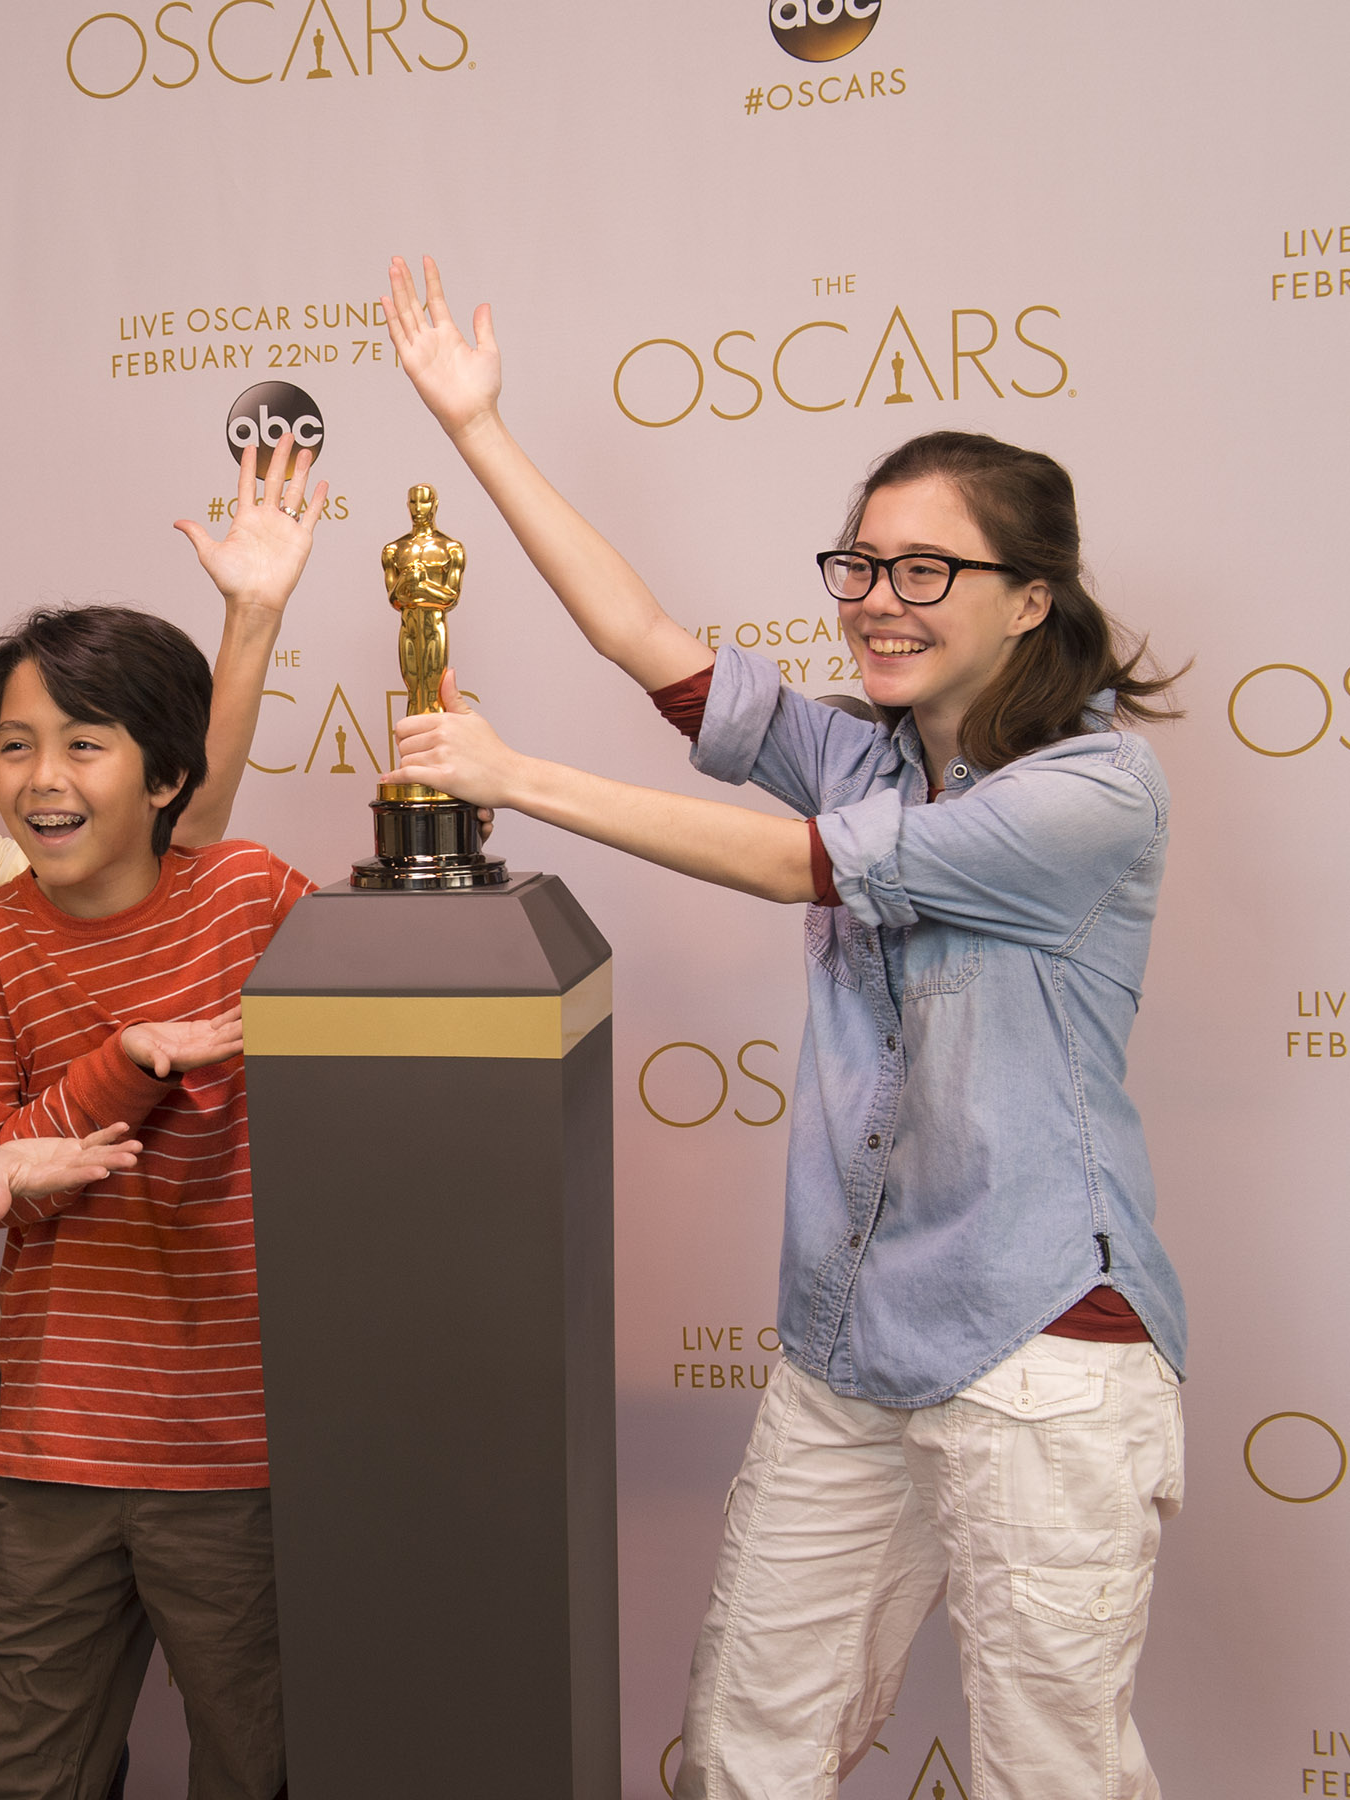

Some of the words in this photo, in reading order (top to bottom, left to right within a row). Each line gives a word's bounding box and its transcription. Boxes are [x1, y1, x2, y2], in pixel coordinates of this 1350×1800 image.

[744, 67, 907, 116] #OSCARS
[1283, 225, 1350, 258] LIVE
[811, 274, 857, 297] THE
[119, 311, 175, 341] LIVE
[186, 305, 291, 333] OSCAR
[303, 301, 390, 330] SUND
[111, 343, 254, 379] FEBRUARY
[267, 343, 339, 368] 22ND
[351, 340, 383, 365] 7E
[228, 404, 323, 448] abc
[274, 650, 301, 667] HE
[1297, 991, 1347, 1018] LIV
[682, 1326, 743, 1352] LIVE
[674, 1364, 769, 1390] FEBRU
